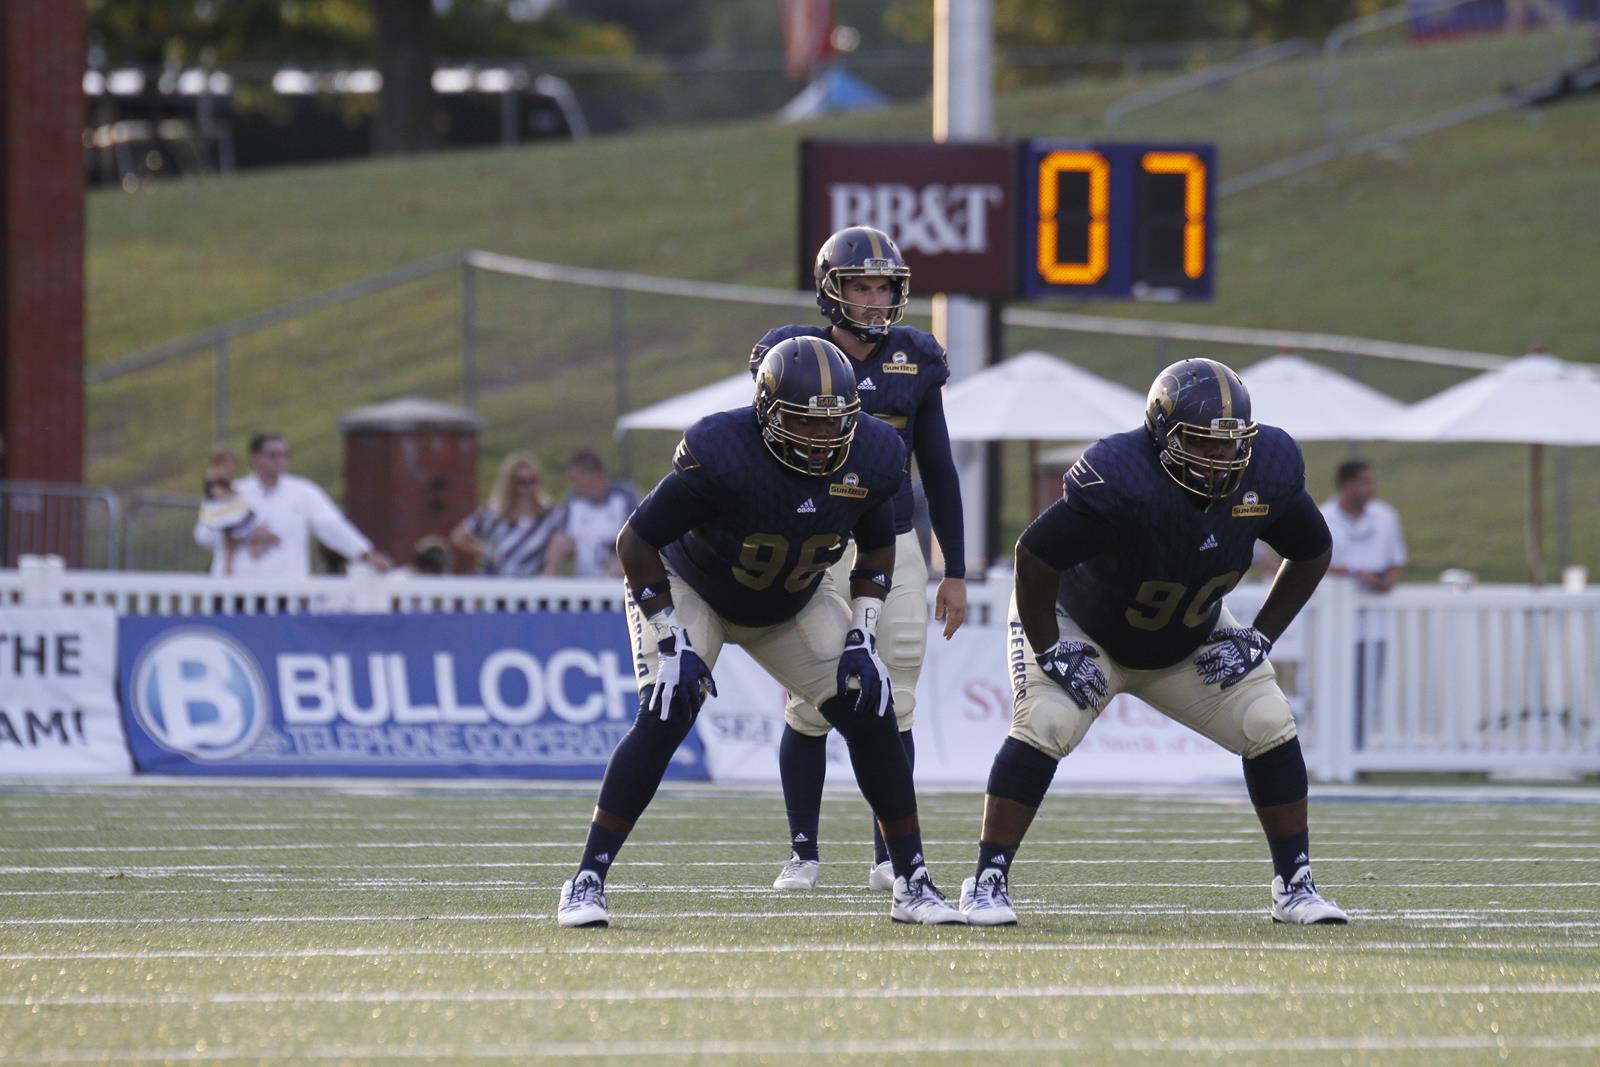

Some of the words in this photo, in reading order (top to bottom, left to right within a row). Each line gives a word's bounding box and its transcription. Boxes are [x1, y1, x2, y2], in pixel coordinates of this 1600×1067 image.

[829, 182, 1002, 255] BB&T
[1038, 151, 1206, 284] 07
[731, 532, 841, 593] 96
[0, 634, 81, 677] HE
[276, 650, 637, 726] BULLOCH
[287, 726, 462, 757] TELEPHONE
[464, 725, 630, 757] COOPERAT
